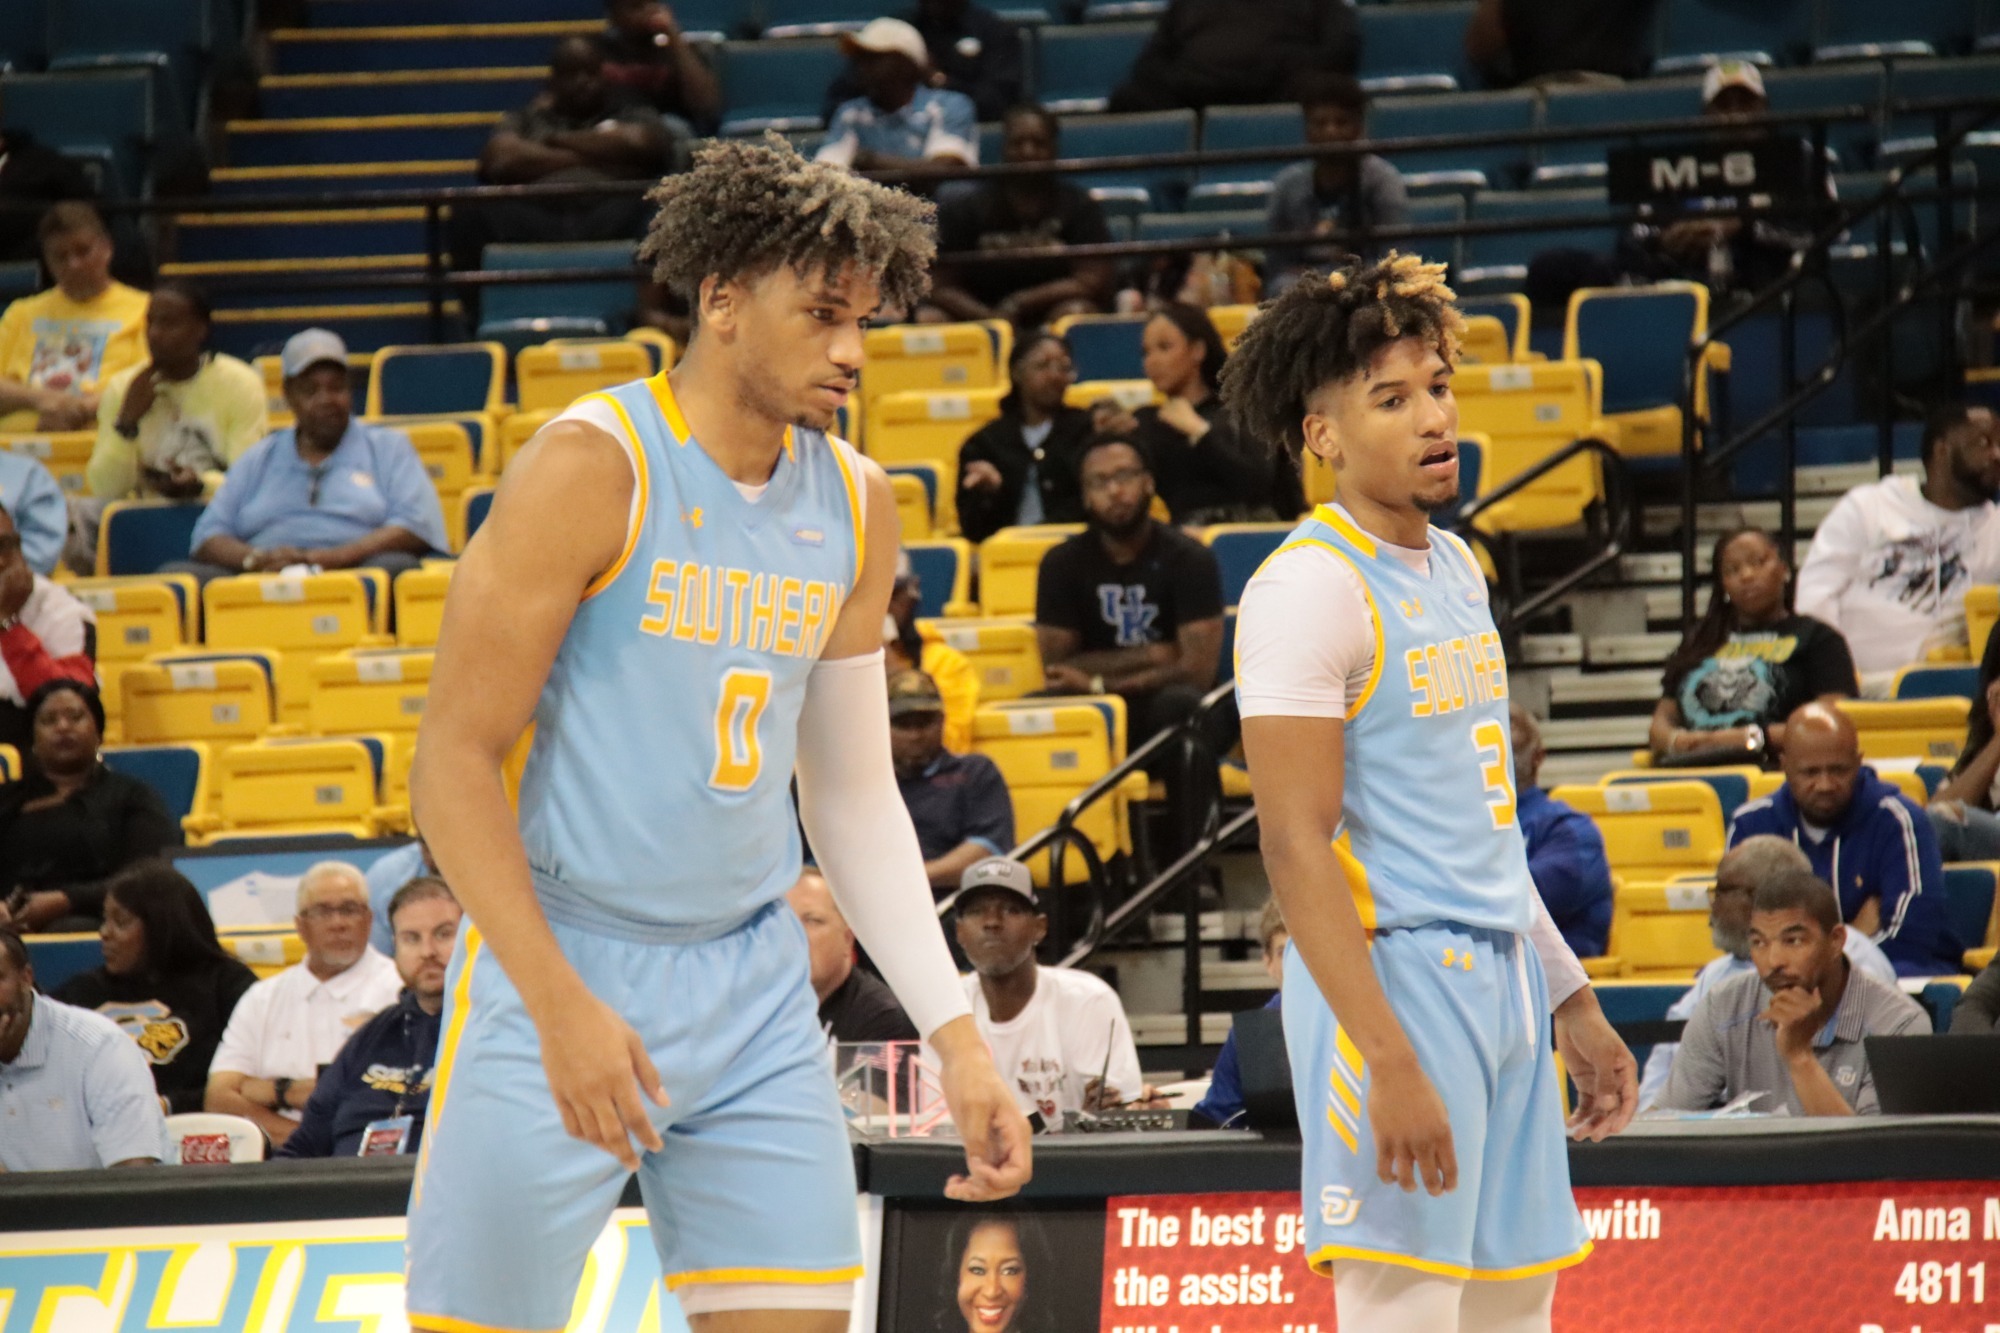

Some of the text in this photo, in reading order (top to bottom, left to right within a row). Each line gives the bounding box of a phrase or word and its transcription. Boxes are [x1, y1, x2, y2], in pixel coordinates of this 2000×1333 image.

[639, 558, 846, 660] SOUTHERN
[1097, 584, 1160, 647] UK
[707, 666, 772, 792] 0
[1470, 719, 1517, 831] 3
[1117, 1207, 1180, 1247] The
[1190, 1206, 1265, 1247] best
[1582, 1198, 1661, 1241] with
[1320, 1185, 1363, 1226] SU
[1873, 1198, 1971, 1241] Anna
[1113, 1264, 1295, 1306] the assist.
[1894, 1261, 1985, 1304] 4811
